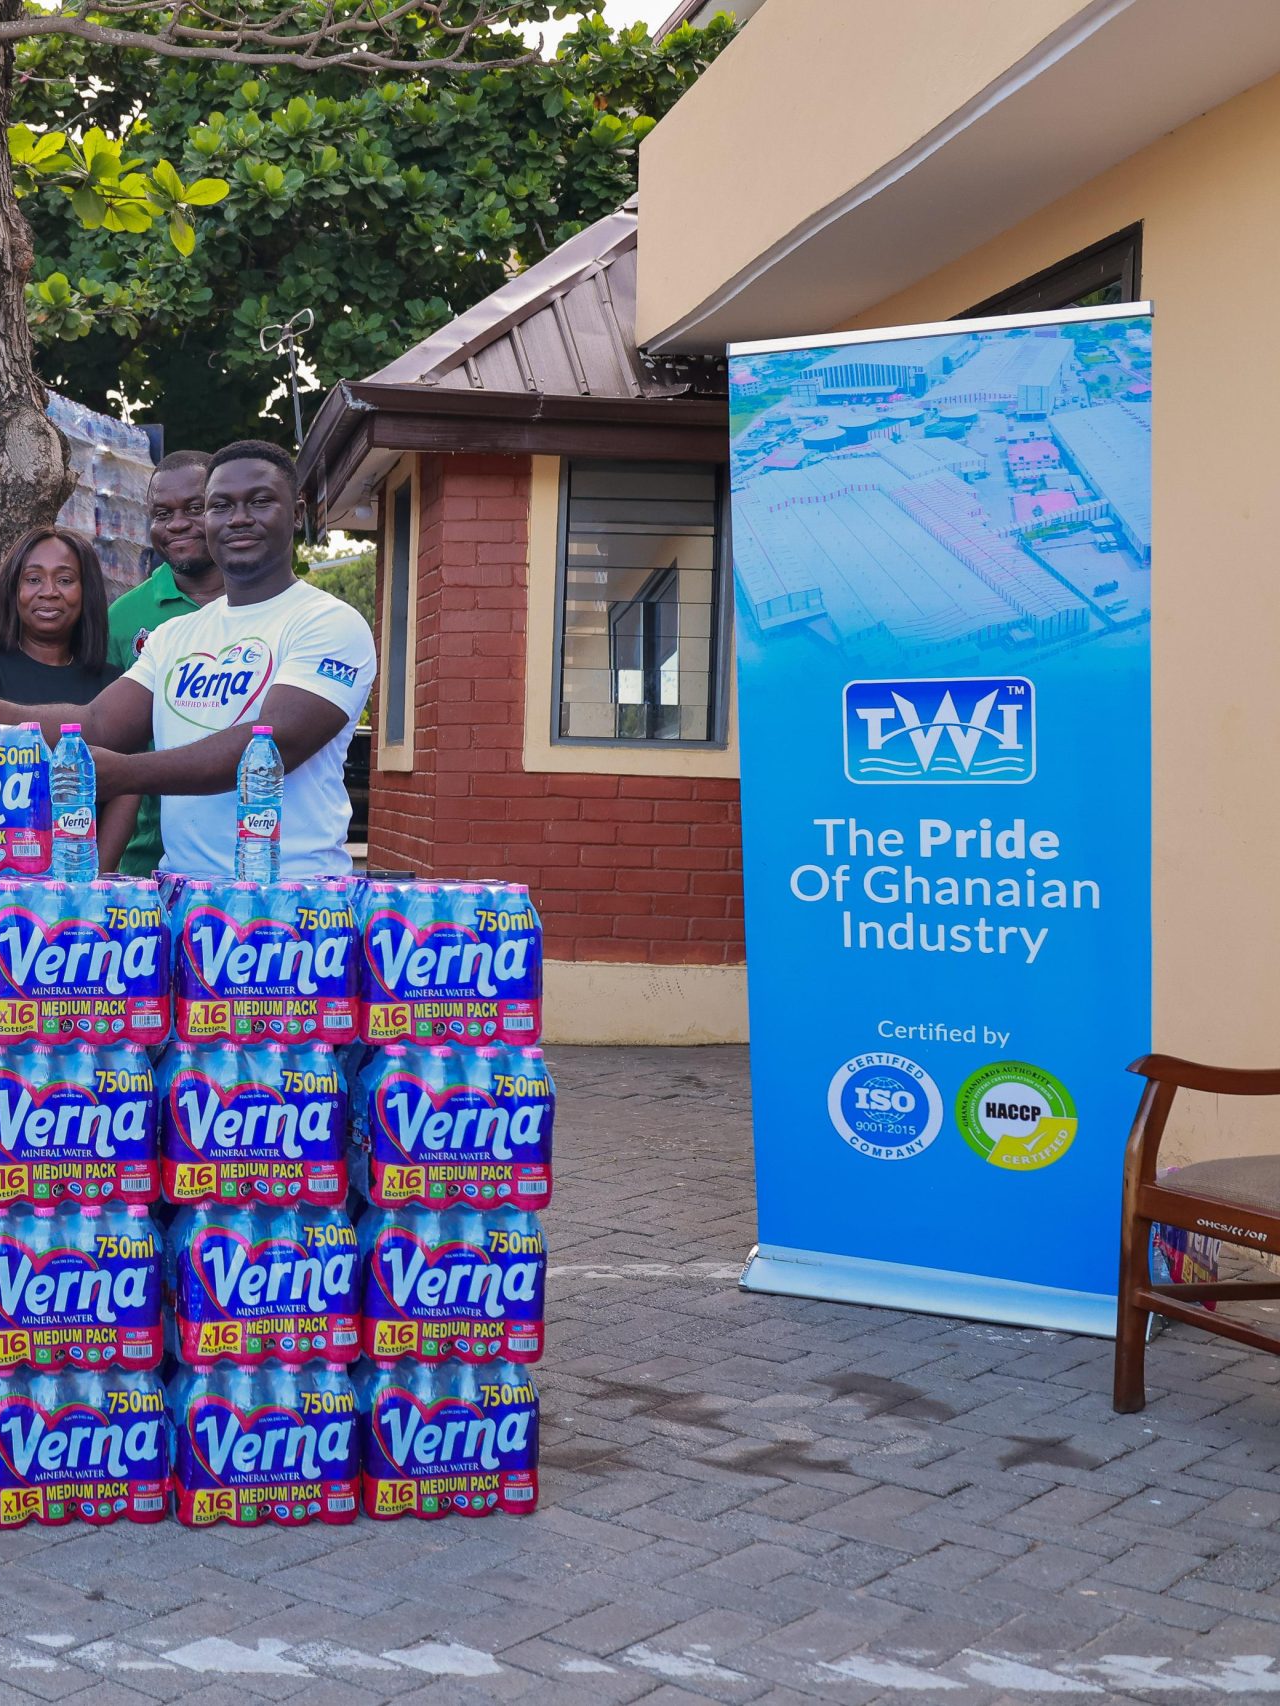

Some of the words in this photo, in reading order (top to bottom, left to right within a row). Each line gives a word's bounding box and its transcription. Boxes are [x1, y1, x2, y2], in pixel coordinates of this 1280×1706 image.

[176, 663, 254, 705] Verna
[174, 700, 201, 708] PURIFIED
[855, 689, 1024, 773] TWI
[1006, 686, 1025, 695] TM
[62, 815, 90, 832] Verna
[248, 816, 275, 830] Verna
[813, 817, 904, 857] The
[919, 818, 1060, 860] Pride
[789, 864, 850, 902] Of
[863, 865, 1101, 909] Ghanaian
[843, 911, 1049, 964] Industry
[0, 927, 156, 995] Verna
[192, 926, 349, 994] Verna
[370, 929, 529, 997] Verna
[877, 1019, 976, 1044] Certified
[983, 1026, 1010, 1049] by
[847, 1055, 924, 1080] CERTIFIED
[966, 1069, 1000, 1098] STANDARDS
[1002, 1066, 1050, 1085] AUTHORITY
[854, 1087, 916, 1113] ISO
[986, 1102, 1041, 1122] HACCP
[179, 1091, 334, 1159] Verna
[386, 1092, 543, 1160] Verna
[855, 1121, 916, 1135] 9001:2015
[849, 1136, 925, 1158] COMPANY
[1002, 1129, 1068, 1165] CERTIFIED
[204, 1246, 354, 1312] Verna
[383, 1248, 538, 1317] Verna
[481, 1383, 534, 1407] 750ml
[1, 1416, 159, 1477] Verna
[196, 1411, 352, 1479] Verna
[381, 1409, 530, 1470] Verna
[411, 1464, 449, 1474] MINERAL
[450, 1463, 479, 1471] WATER
[378, 1502, 412, 1513] Bottles
[380, 1483, 414, 1504] x16
[420, 1477, 468, 1494] MEDIUM
[471, 1474, 499, 1490] PACK
